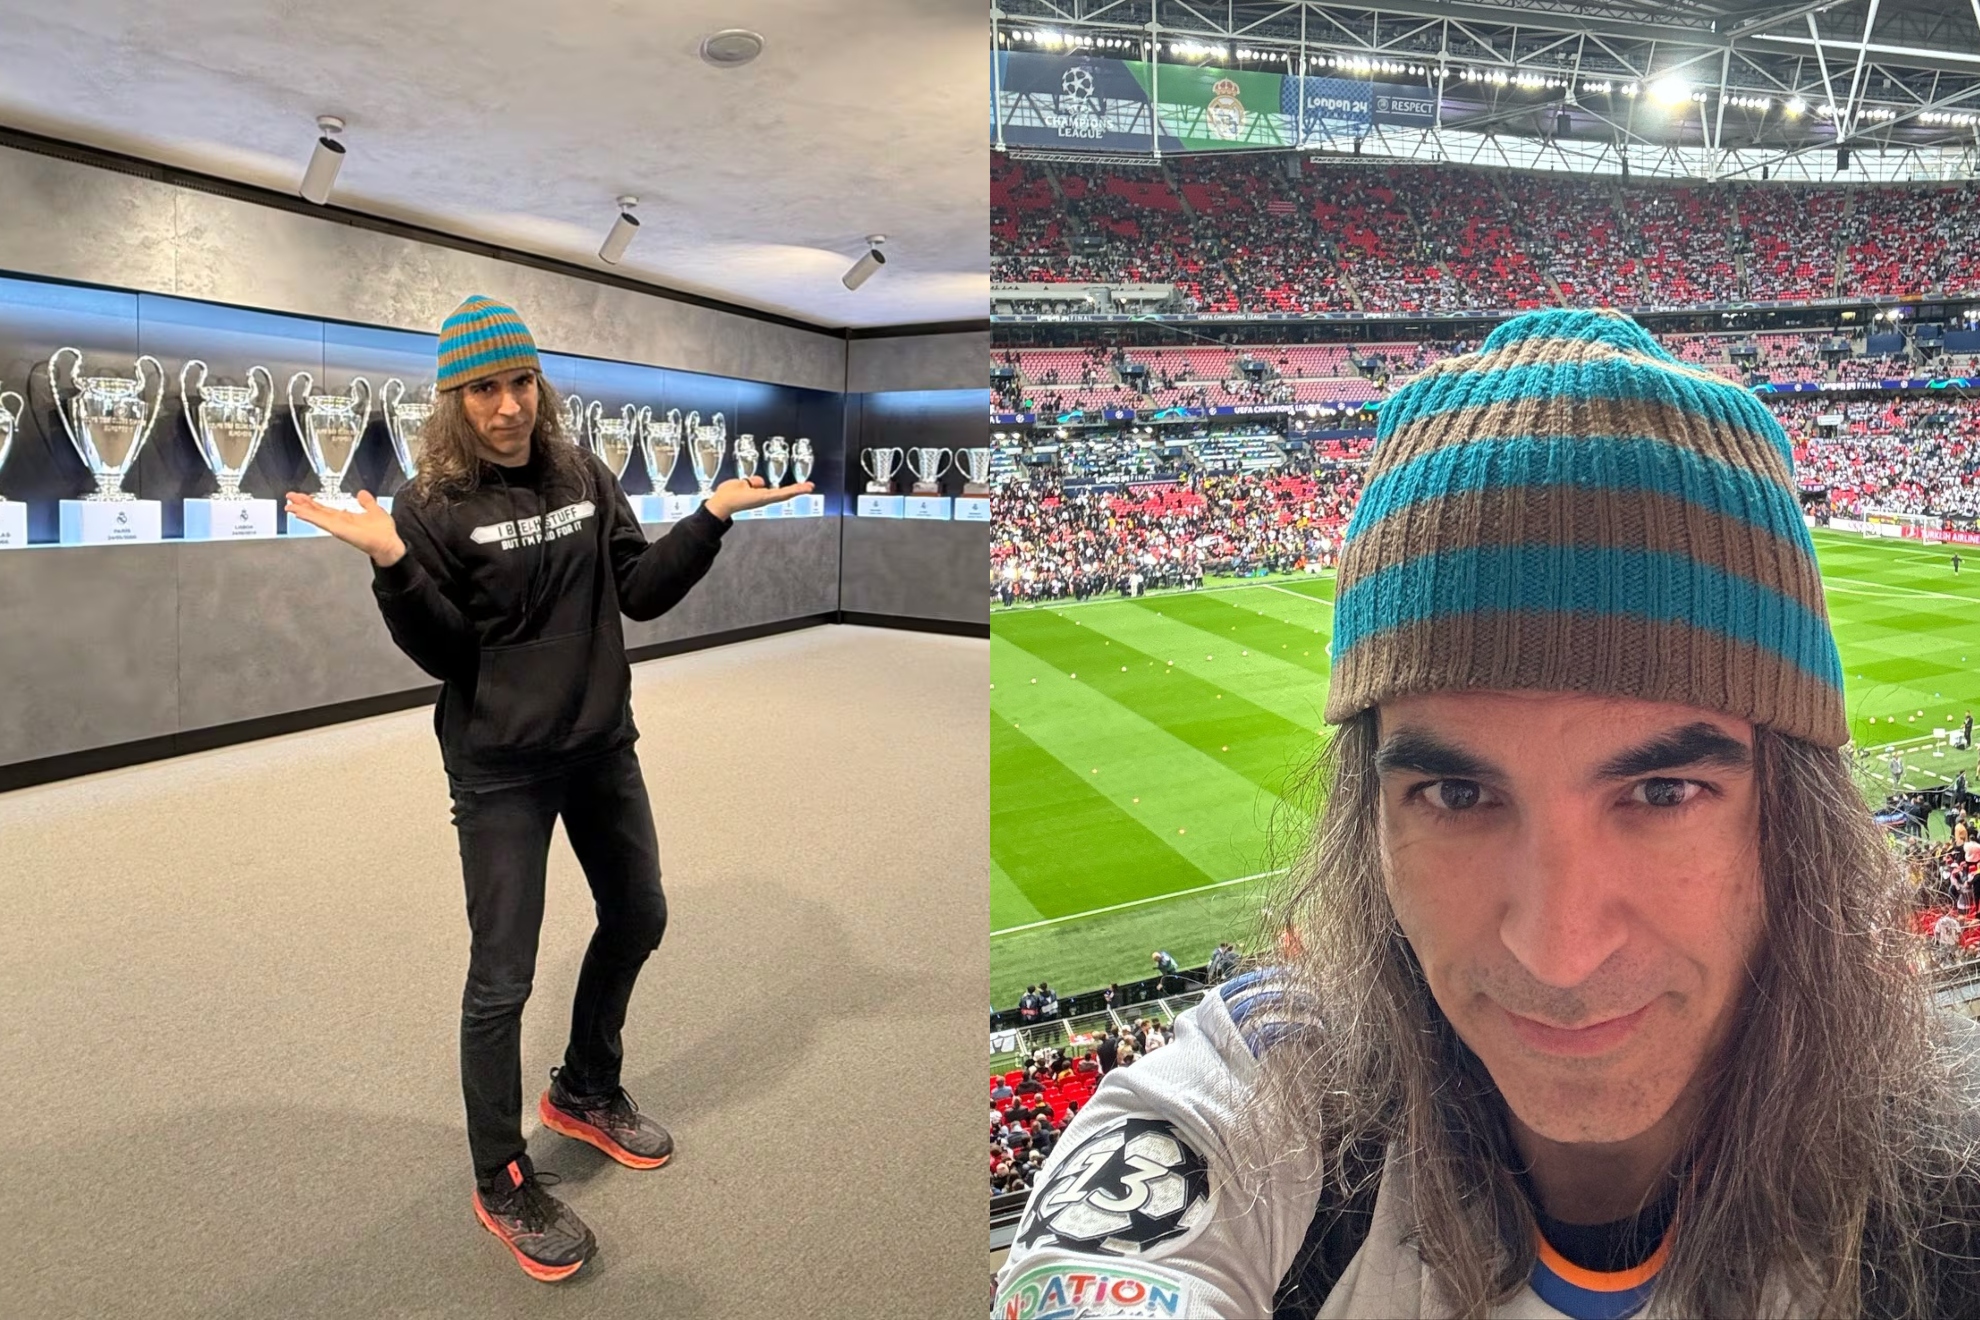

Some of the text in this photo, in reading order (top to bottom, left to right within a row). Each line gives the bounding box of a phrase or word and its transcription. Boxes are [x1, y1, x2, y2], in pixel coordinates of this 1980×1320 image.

[1352, 100, 1368, 113] 24
[1391, 100, 1434, 114] RESPECT
[1044, 115, 1114, 129] CHAMPIONS
[1058, 128, 1103, 139] LEAGUE
[1857, 382, 1882, 390] FINAL
[1234, 404, 1321, 414] UEFA CHAMPIONS LEAGUE
[498, 526, 502, 537] I
[501, 538, 520, 550] BUT
[522, 536, 535, 546] I'M
[556, 524, 574, 538] FOR
[573, 520, 583, 531] IT
[1049, 1149, 1169, 1213] 13
